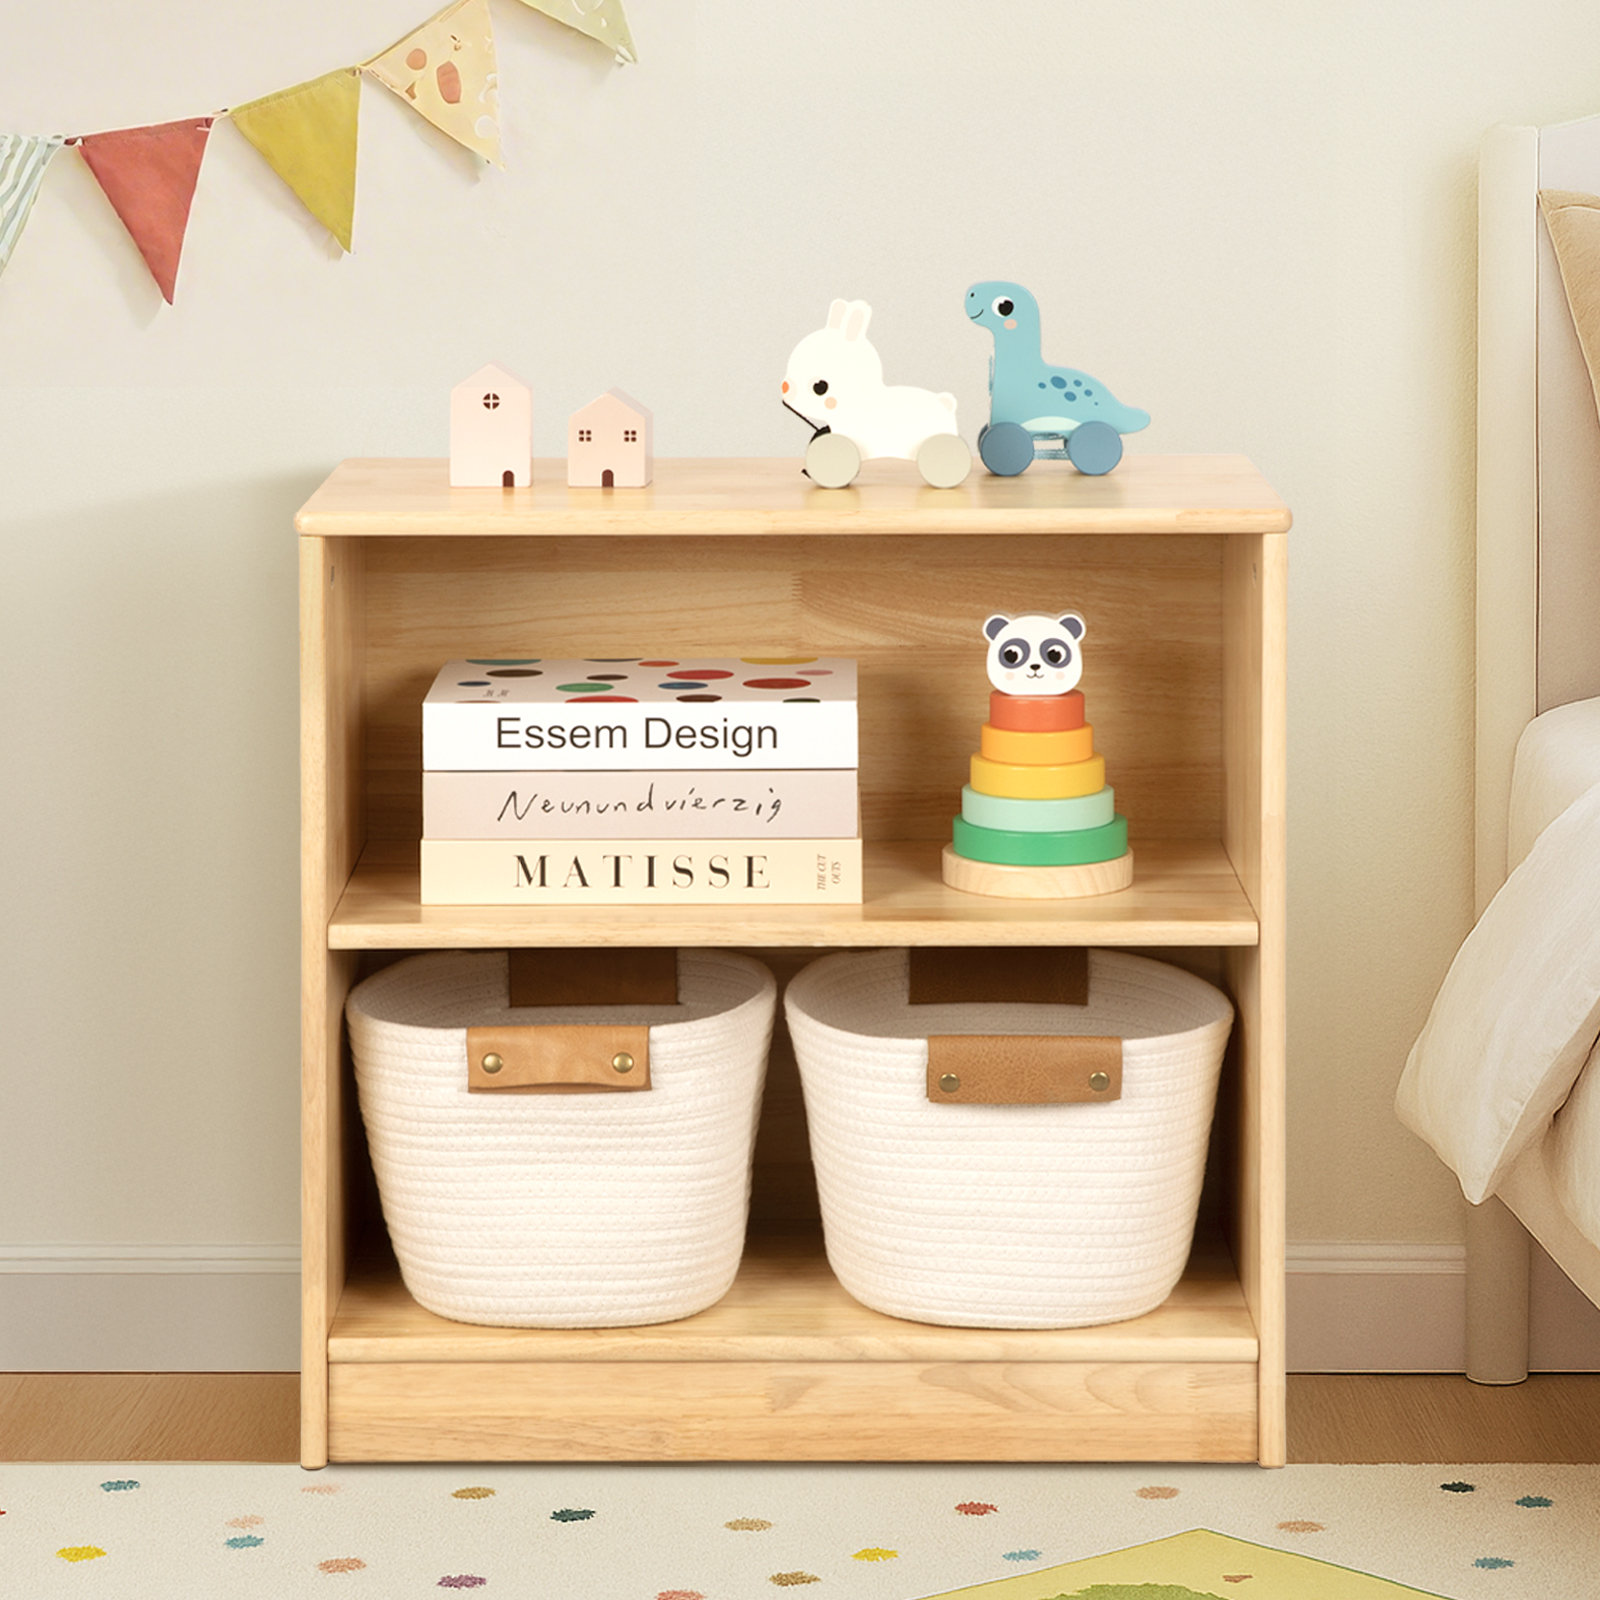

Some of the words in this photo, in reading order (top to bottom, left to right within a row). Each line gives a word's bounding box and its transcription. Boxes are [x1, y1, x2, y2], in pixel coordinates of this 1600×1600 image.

[497, 717, 627, 749] Essem
[644, 717, 778, 758] Design
[513, 854, 770, 889] MATISSE
[816, 853, 827, 872] CUT
[816, 872, 827, 891] THE
